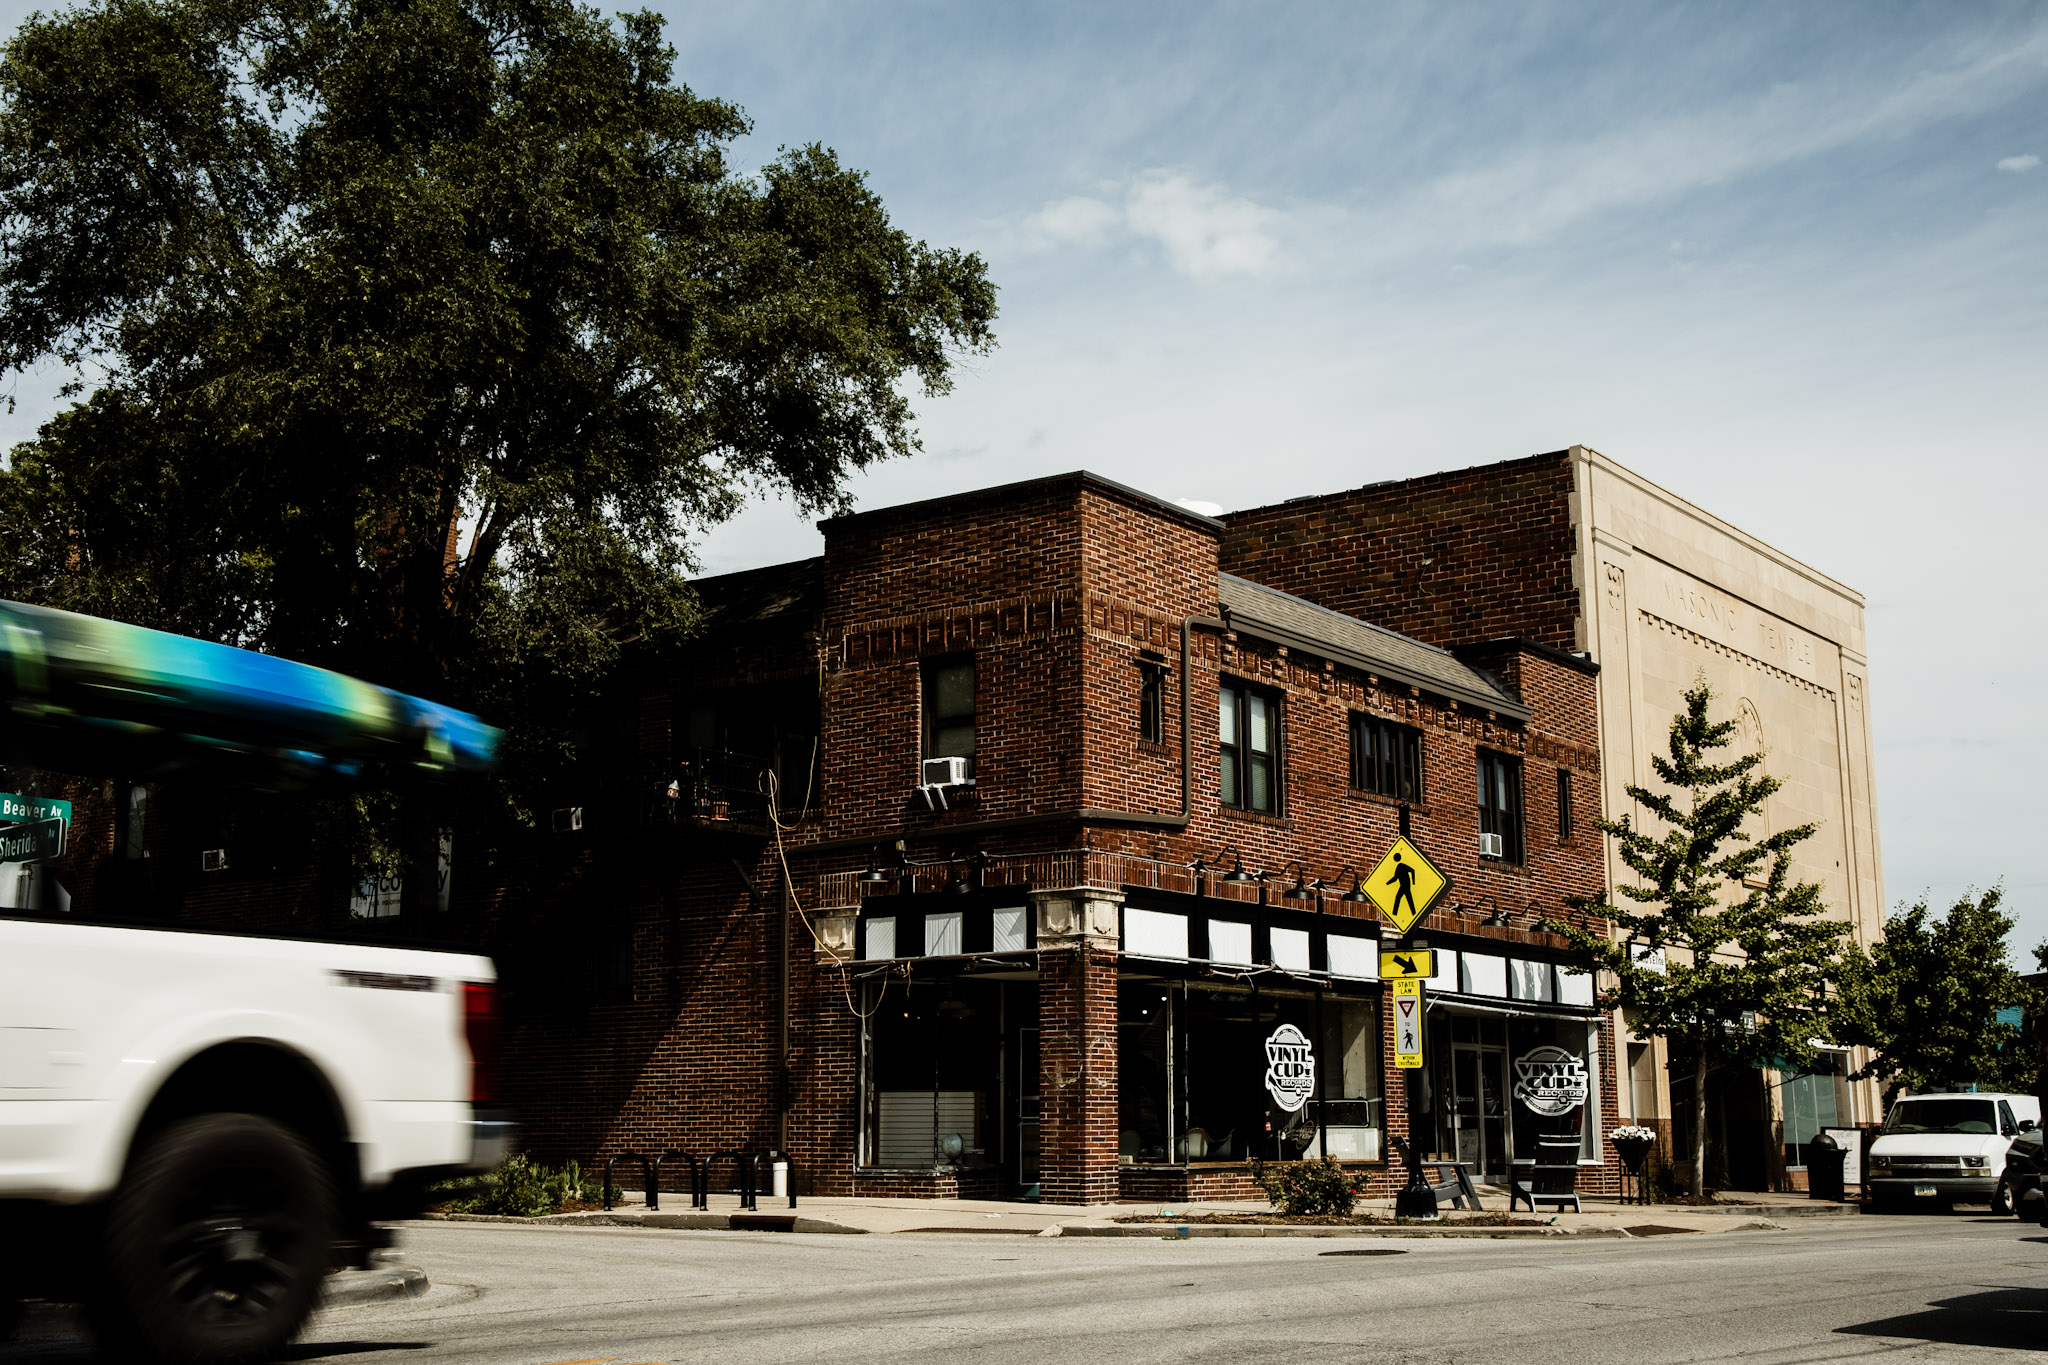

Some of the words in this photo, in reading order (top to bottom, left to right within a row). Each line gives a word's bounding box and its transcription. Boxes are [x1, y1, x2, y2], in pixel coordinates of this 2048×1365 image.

[1664, 579, 1737, 632] MASONIC
[1759, 623, 1811, 665] TEMPLE
[3, 799, 46, 819] Beaver
[0, 832, 41, 857] Sherida
[1269, 1047, 1312, 1062] VINYL
[1274, 1063, 1304, 1078] CUP
[1518, 1065, 1584, 1076] VINYL
[1281, 1079, 1312, 1087] RECORDS
[1526, 1077, 1572, 1089] CUP
